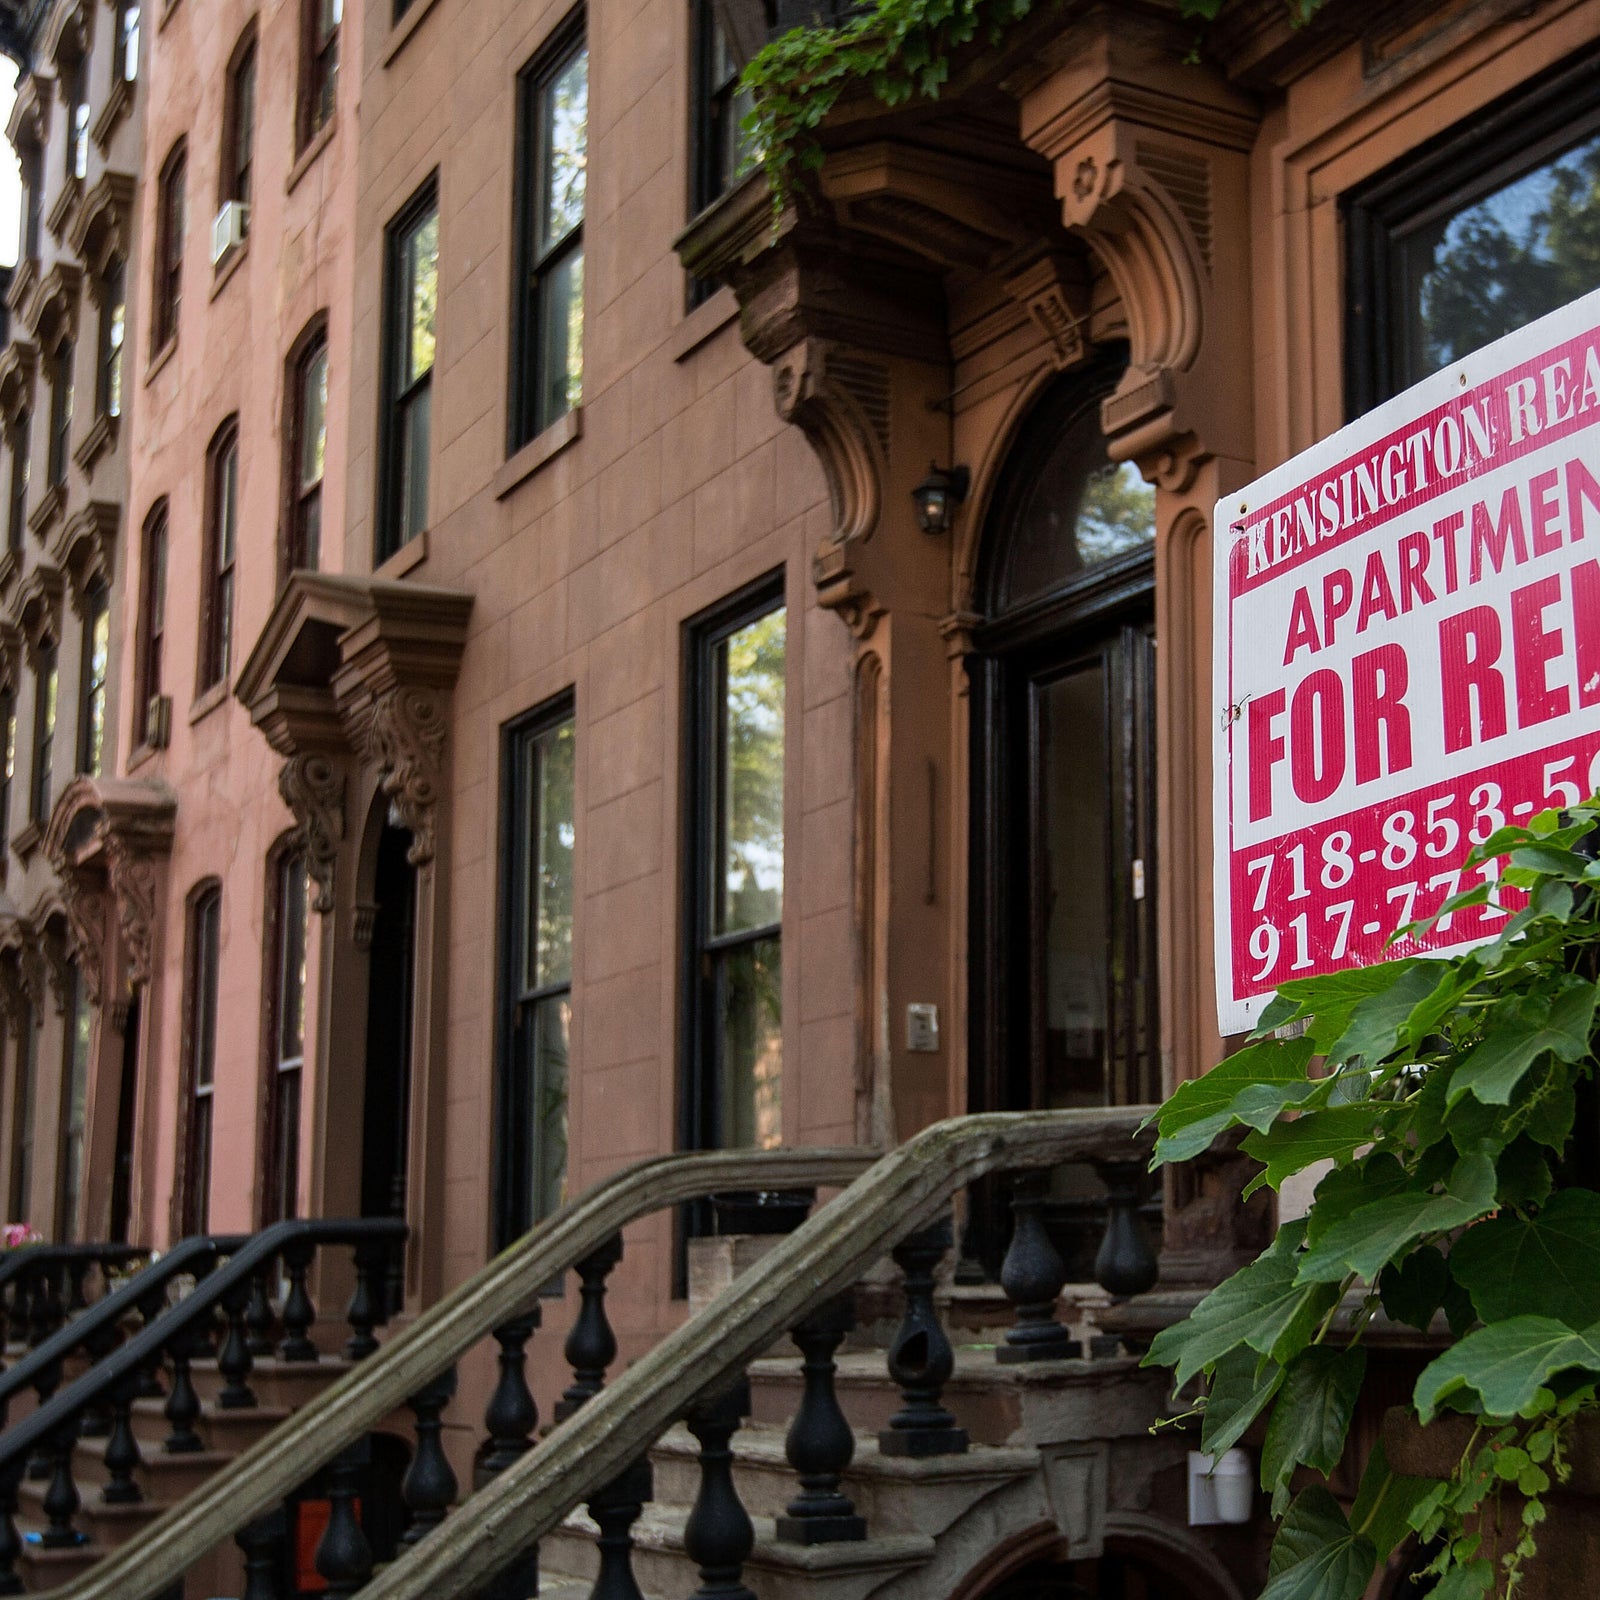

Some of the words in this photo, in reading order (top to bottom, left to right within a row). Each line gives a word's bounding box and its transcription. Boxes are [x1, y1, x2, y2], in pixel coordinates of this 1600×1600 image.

[1246, 397, 1496, 579] KENSINGTON
[1283, 458, 1600, 667] APARTMEN
[1248, 643, 1412, 823] FOR
